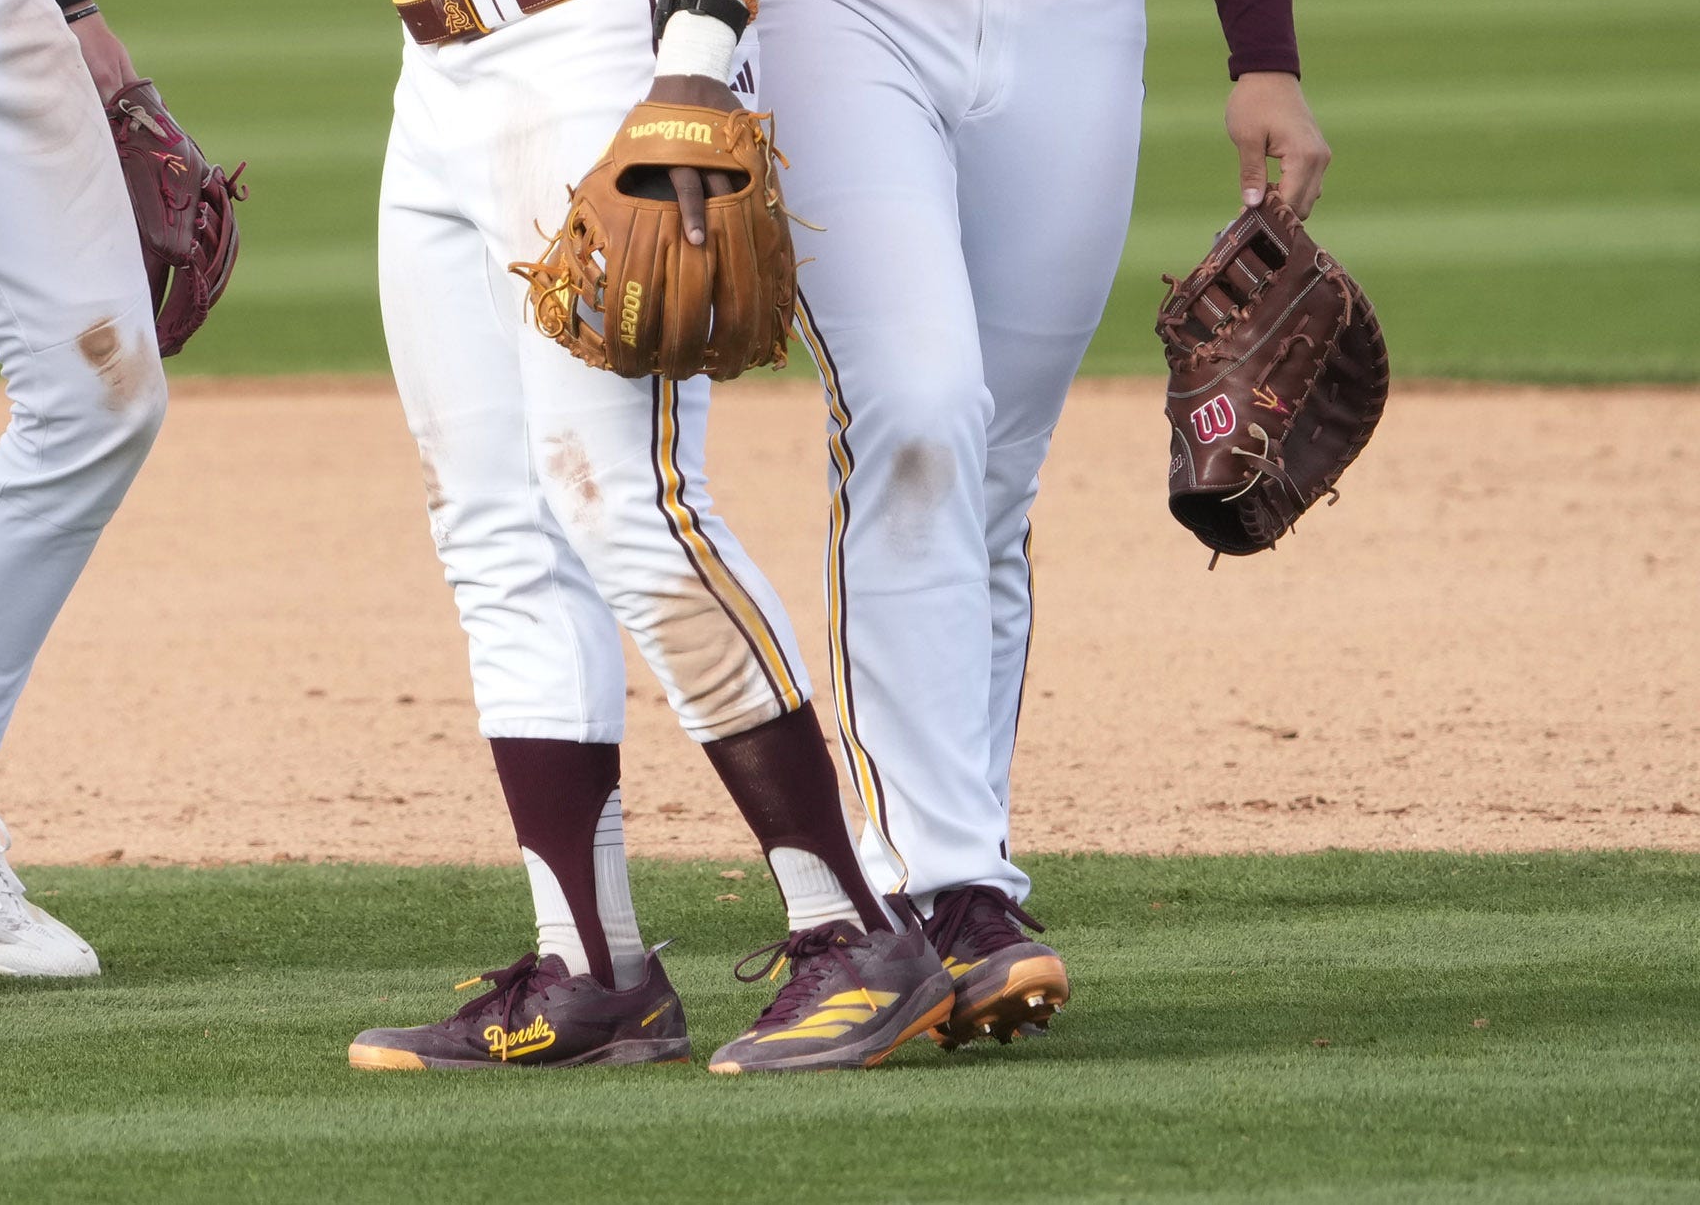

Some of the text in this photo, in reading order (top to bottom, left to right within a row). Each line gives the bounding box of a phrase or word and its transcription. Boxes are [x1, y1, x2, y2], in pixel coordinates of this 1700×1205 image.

[621, 280, 642, 348] A2000
[1191, 393, 1236, 444] W
[484, 1014, 556, 1053] Devils
